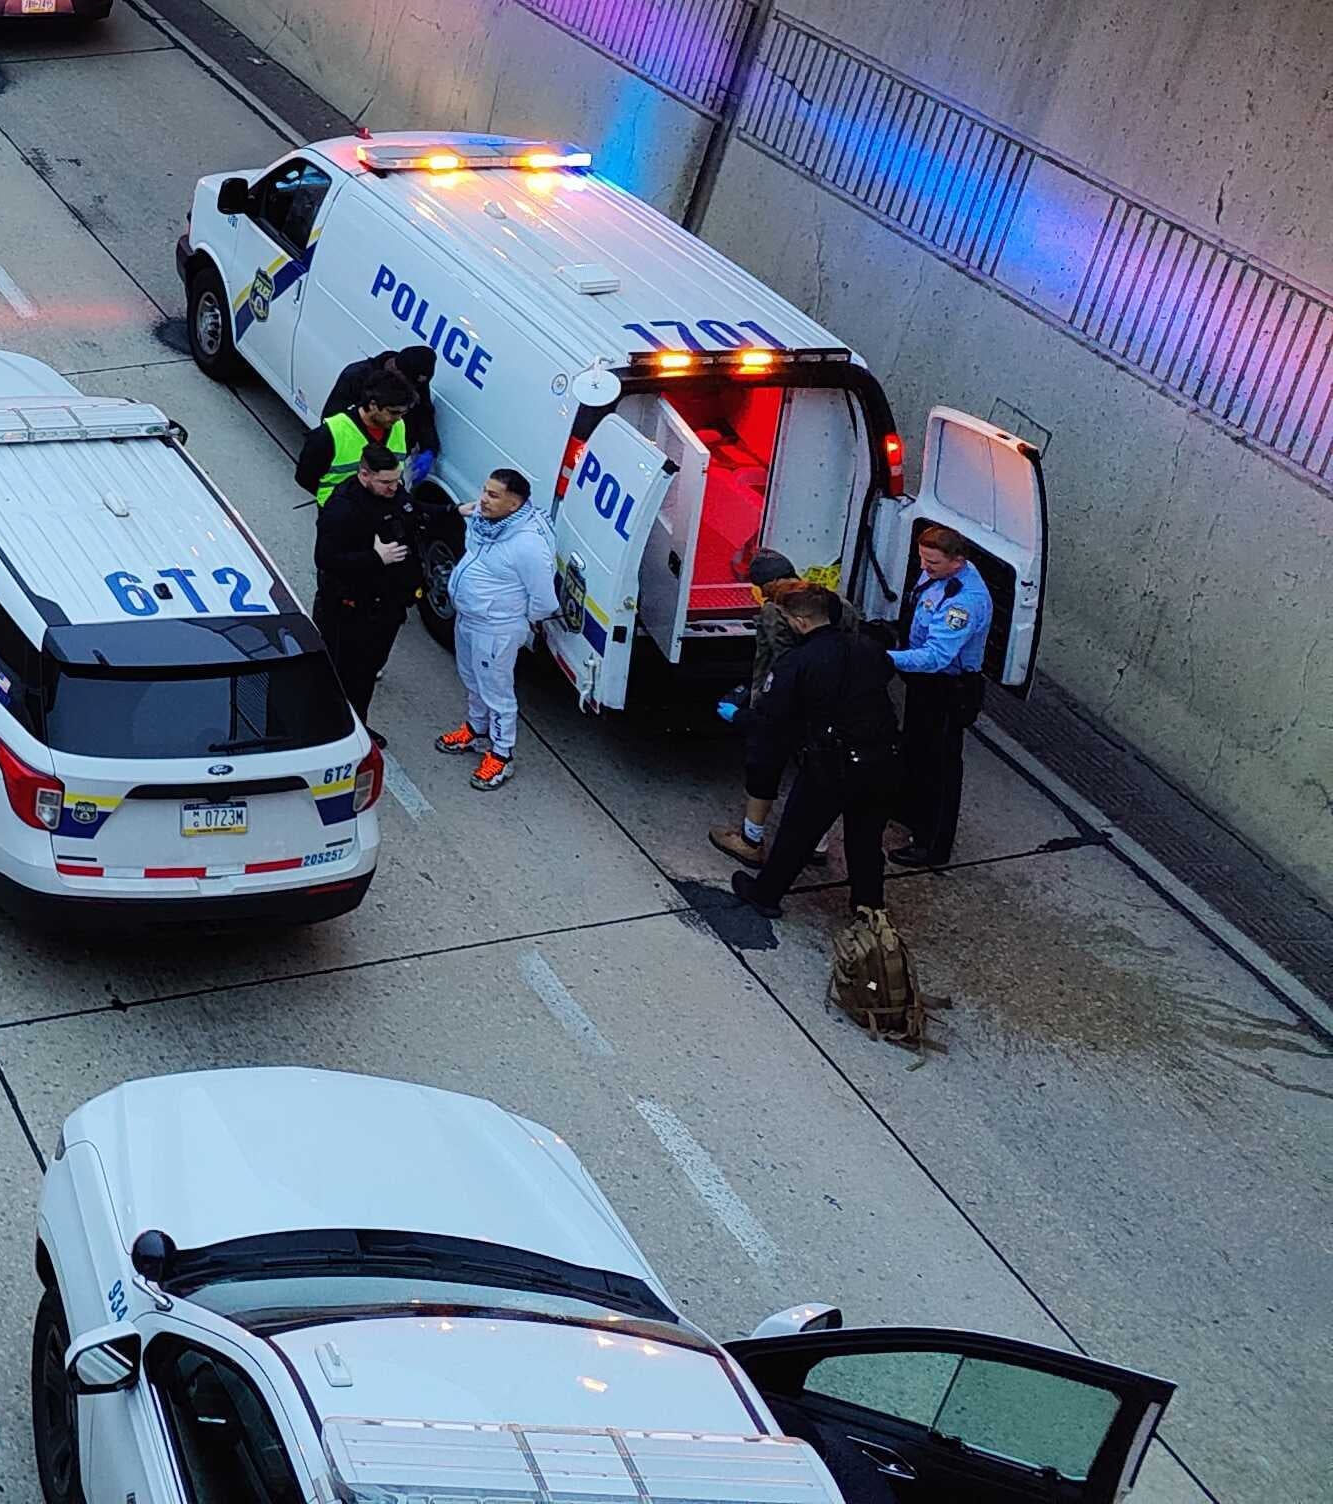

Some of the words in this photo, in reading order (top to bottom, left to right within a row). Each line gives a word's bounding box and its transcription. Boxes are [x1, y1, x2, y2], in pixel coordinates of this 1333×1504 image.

[371, 264, 494, 390] POLICE
[622, 320, 787, 353] 1701
[577, 450, 636, 542] POL
[104, 567, 270, 617] 6T2
[323, 763, 353, 784] 6T2
[303, 849, 344, 867] 205257
